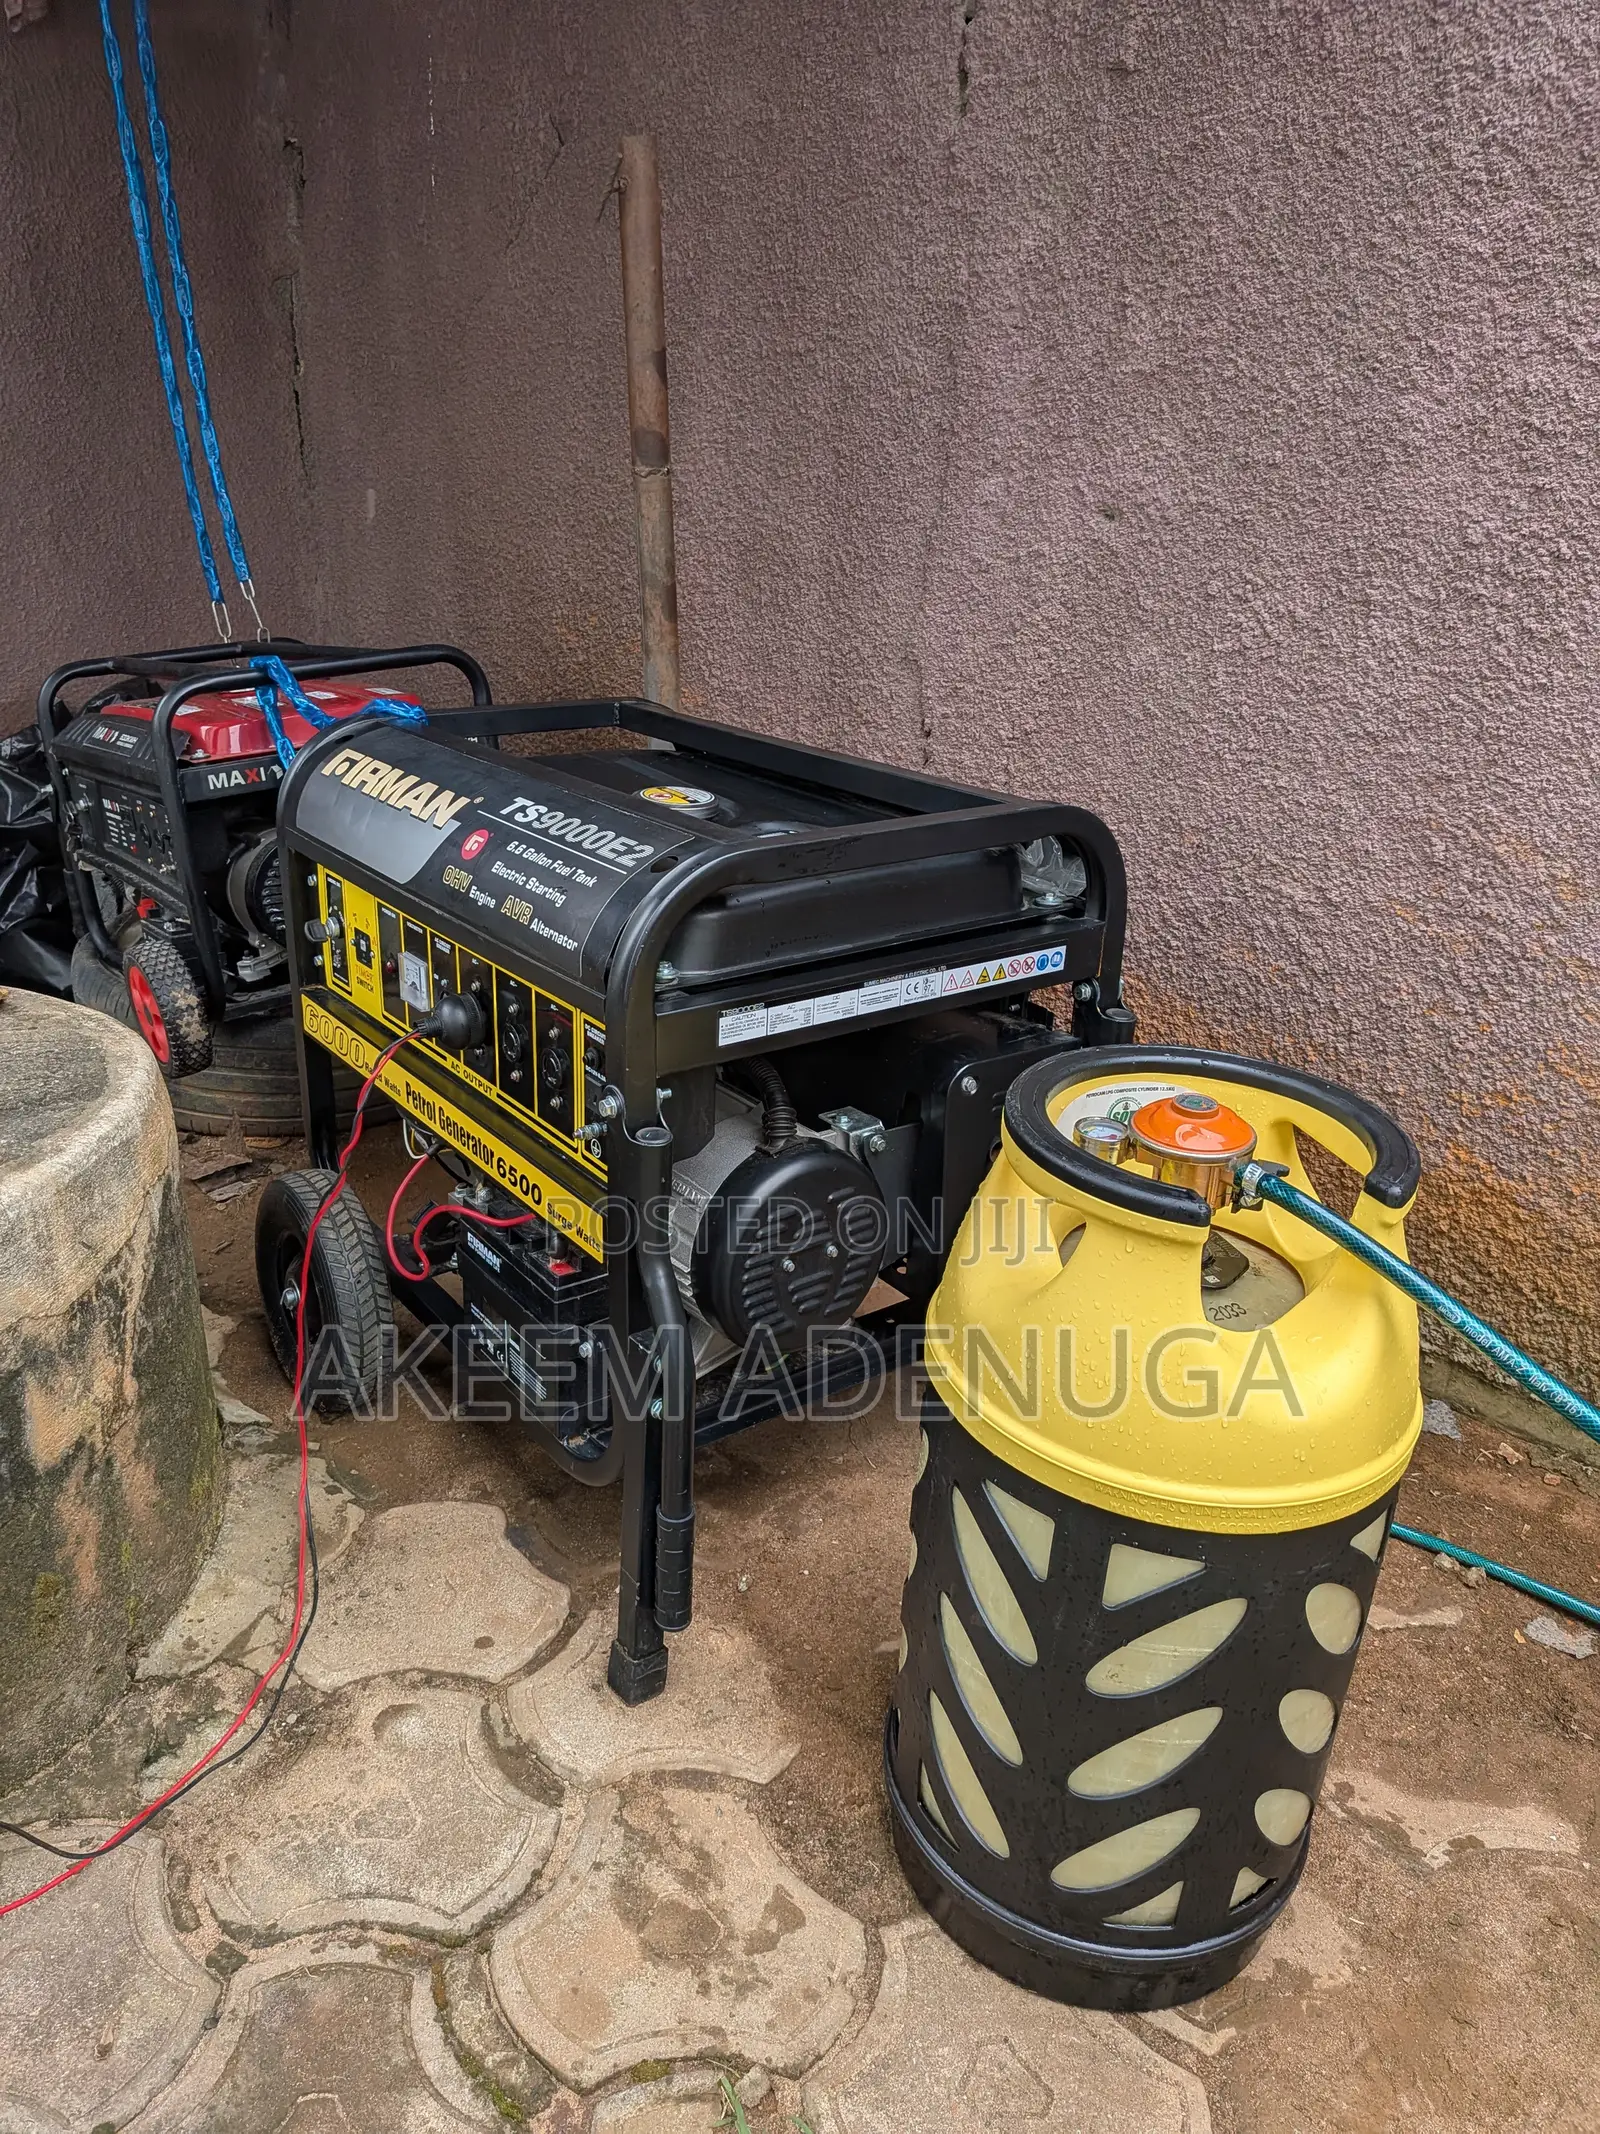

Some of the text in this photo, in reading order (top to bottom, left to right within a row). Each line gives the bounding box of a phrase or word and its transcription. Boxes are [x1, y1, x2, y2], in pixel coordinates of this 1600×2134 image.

[207, 767, 267, 790] MAXI
[321, 748, 471, 830] FIRMAN
[499, 796, 655, 868] TS9000E2
[442, 865, 496, 909] OHV Engine
[491, 861, 567, 908] Electric Starting
[506, 841, 598, 888] 6.6 Gallon Fuel Tank
[501, 895, 578, 951] AVR Alternator
[450, 1061, 493, 1097] AC OUTPUT
[304, 1004, 366, 1069] 6000
[384, 1075, 402, 1097] Watts
[405, 1080, 436, 1124] Petrol
[438, 1106, 495, 1170] Generator
[496, 1157, 542, 1206] 6500
[546, 1202, 573, 1231] Surge
[575, 1223, 601, 1252] Watts
[467, 1231, 501, 1267] FIRMAN
[1209, 1303, 1247, 1321] 2033
[1180, 1504, 1232, 1519] CYLINDER
